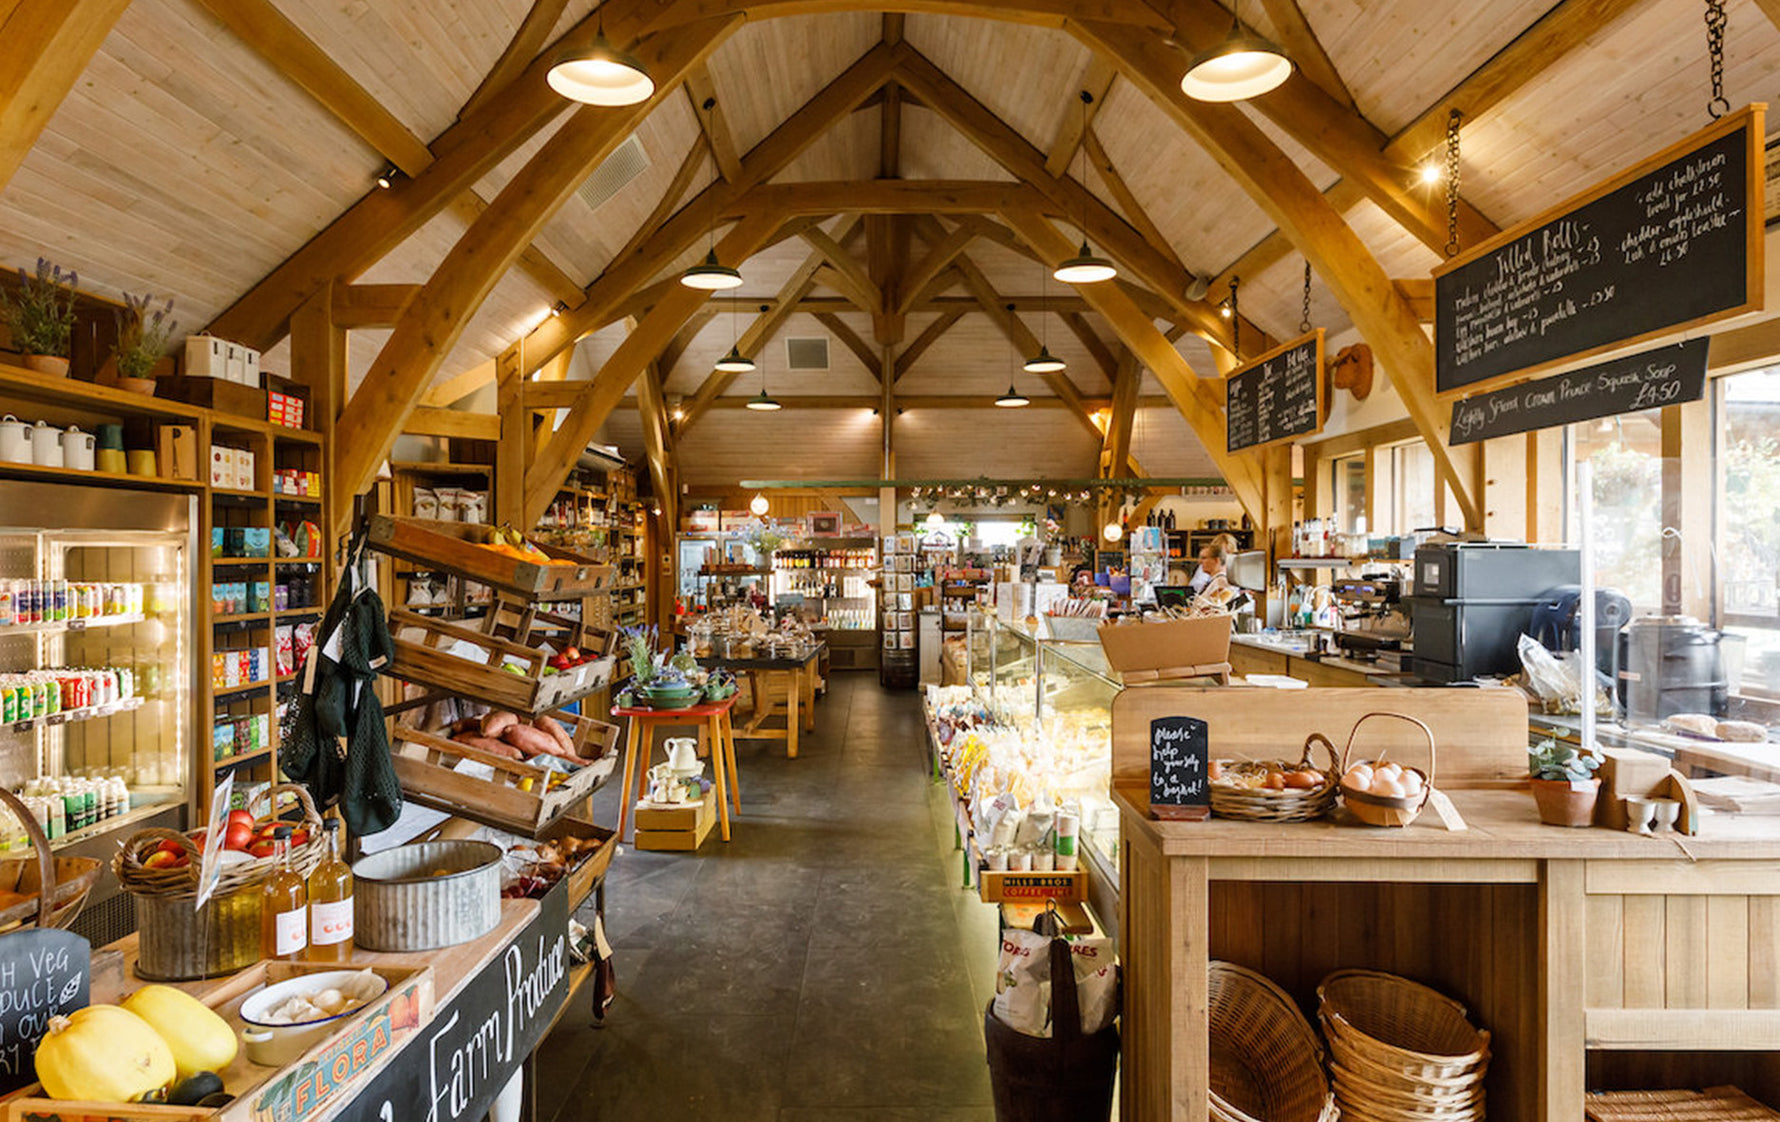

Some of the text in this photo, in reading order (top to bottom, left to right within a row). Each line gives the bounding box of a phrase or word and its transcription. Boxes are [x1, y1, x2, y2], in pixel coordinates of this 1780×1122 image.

[1153, 742, 1178, 761] help
[295, 1025, 388, 1115] FLORA
[425, 1009, 503, 1122] Farm
[505, 934, 565, 1063] Produce
